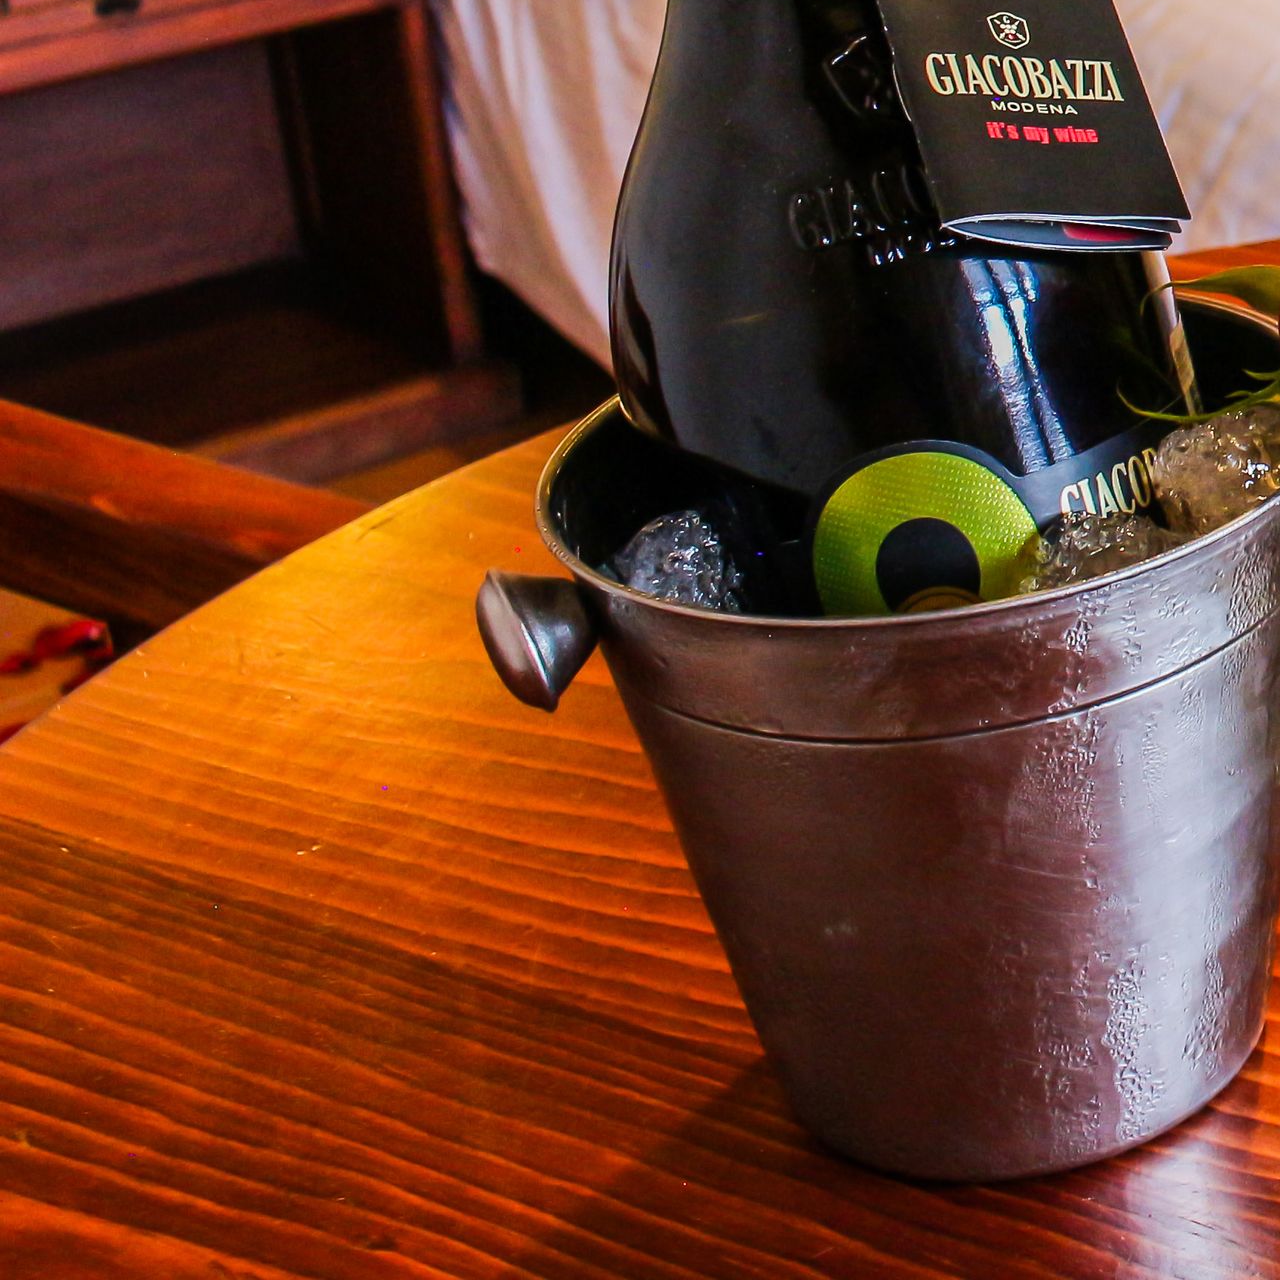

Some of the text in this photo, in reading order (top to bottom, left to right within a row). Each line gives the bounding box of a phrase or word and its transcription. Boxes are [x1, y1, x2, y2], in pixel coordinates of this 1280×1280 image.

[926, 53, 1124, 102] GIACOBAZZI
[991, 100, 1078, 115] MODENA
[986, 121, 1099, 144] it's my wine
